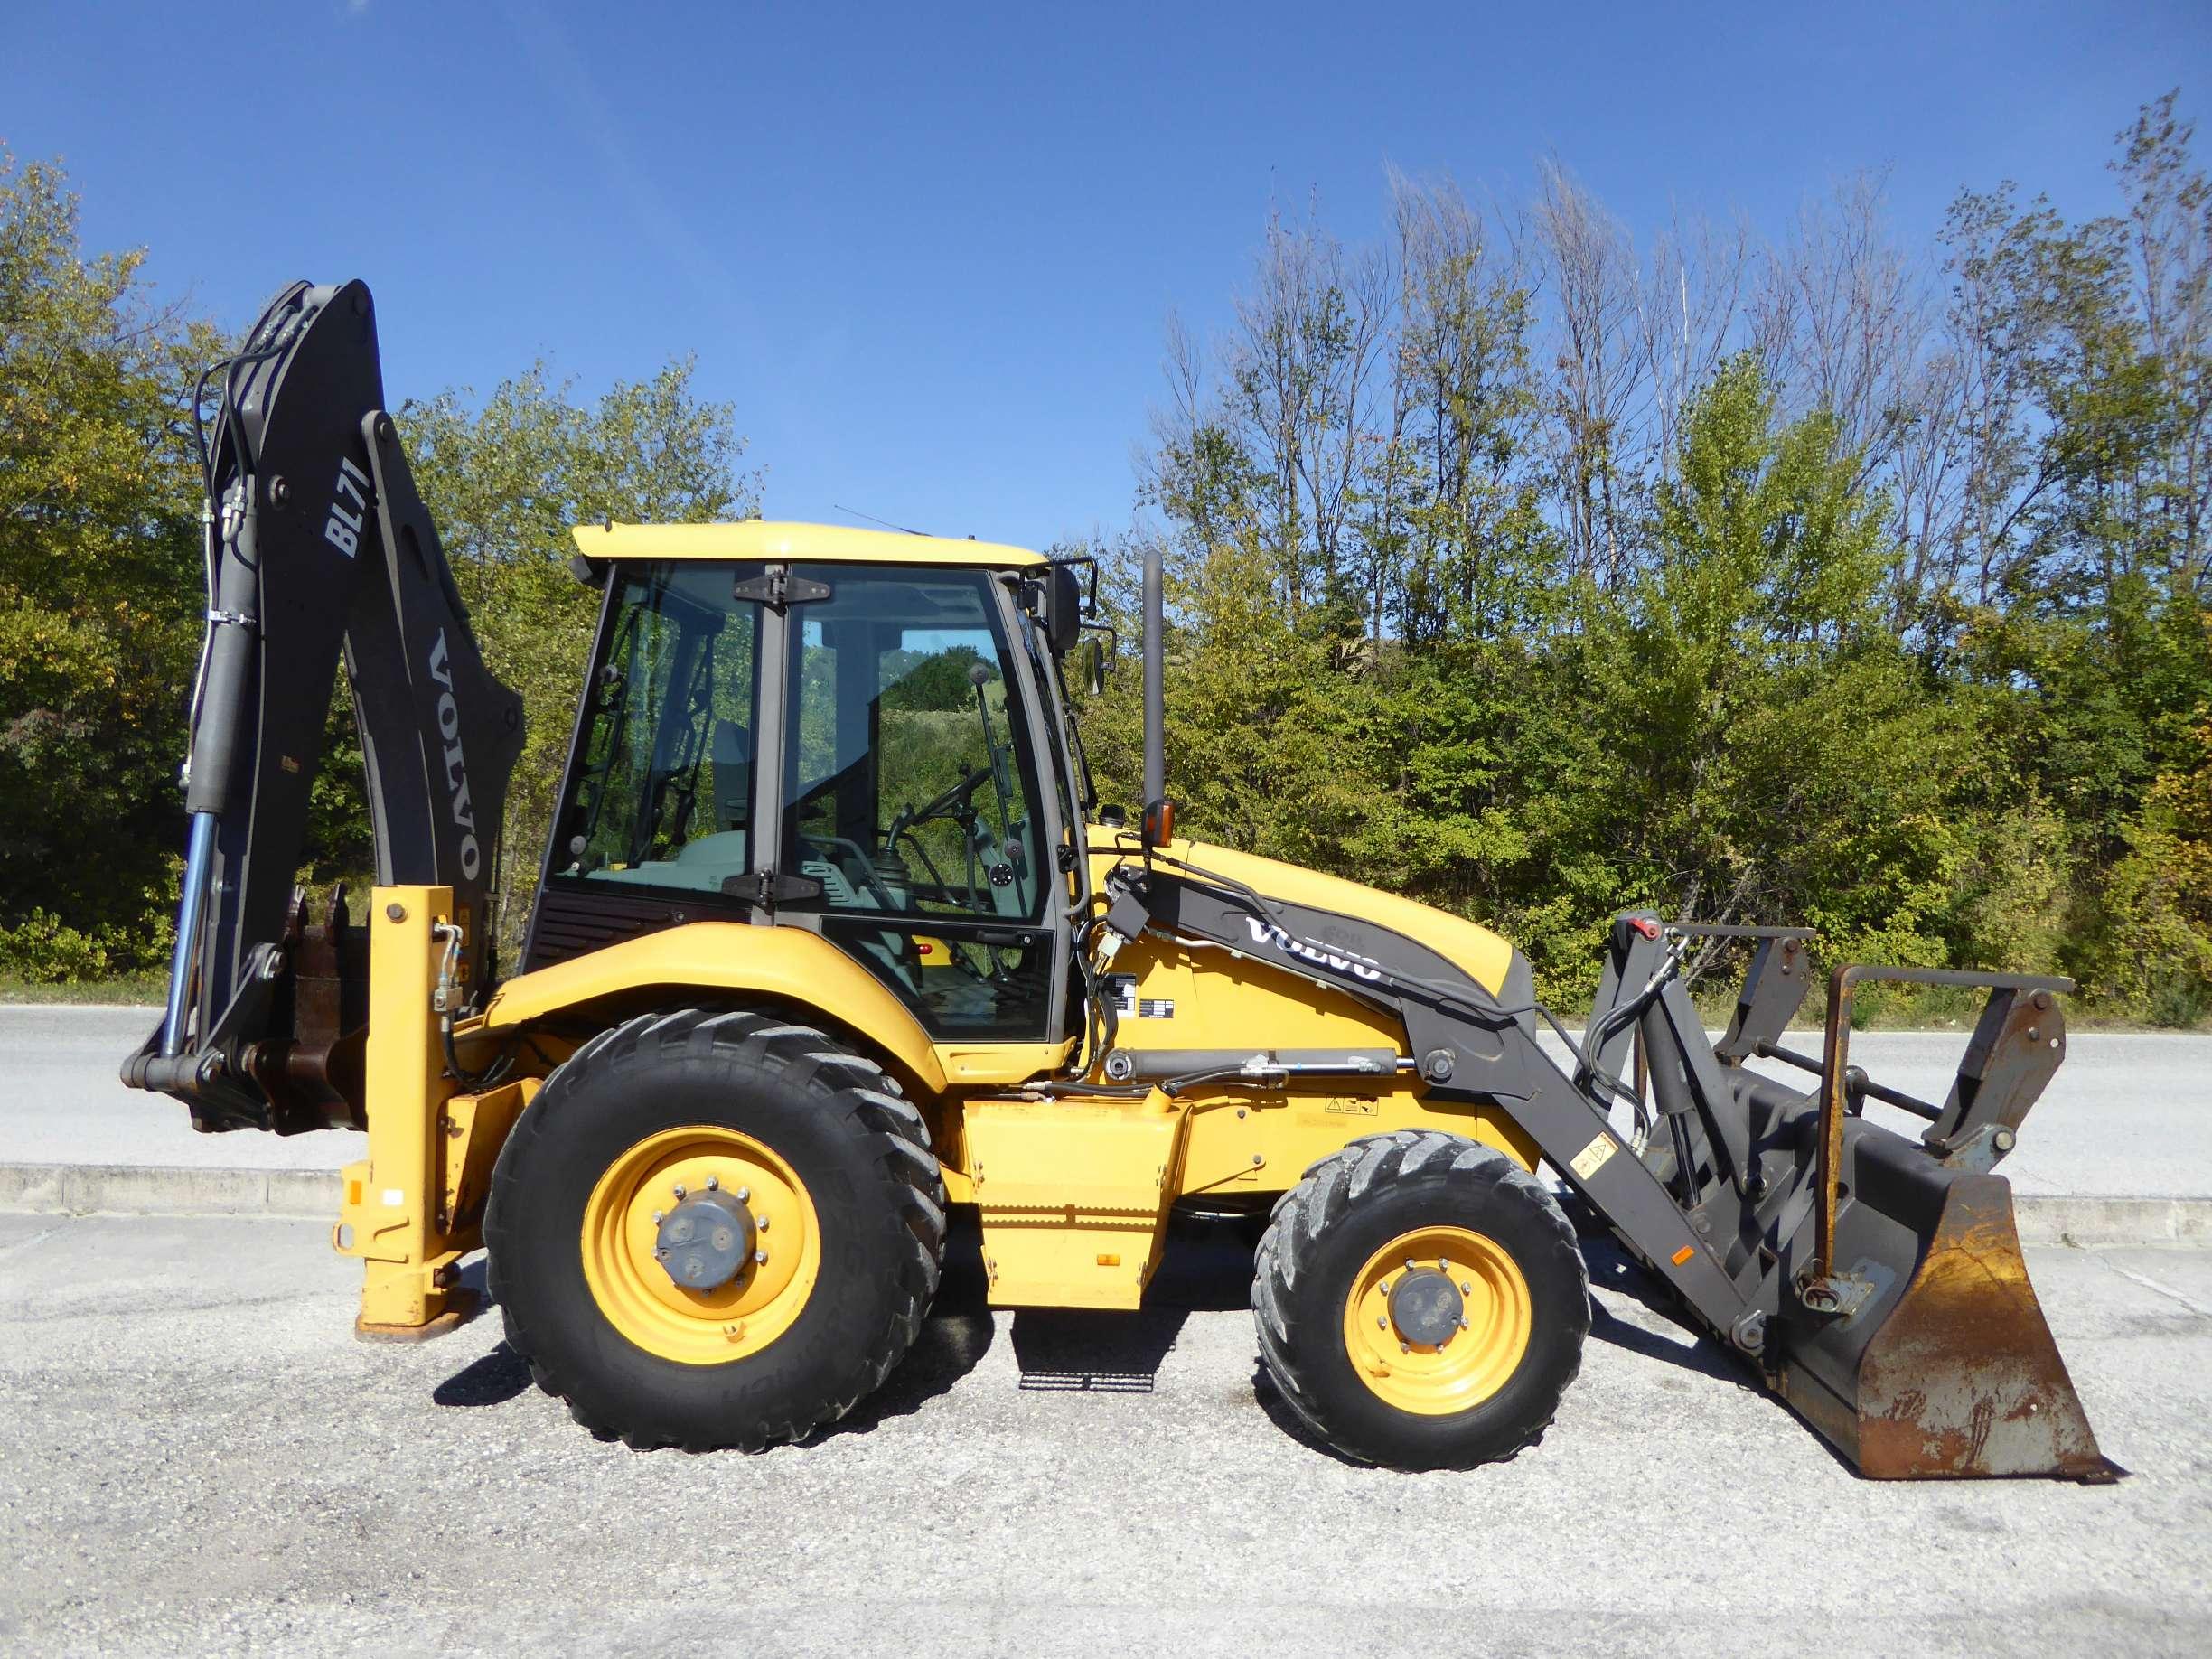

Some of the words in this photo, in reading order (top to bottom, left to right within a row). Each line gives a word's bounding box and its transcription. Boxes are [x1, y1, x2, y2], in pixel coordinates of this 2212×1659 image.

[324, 455, 370, 558] BL71
[429, 627, 481, 881] VOLVO
[1245, 916, 1382, 981] VOLVO
